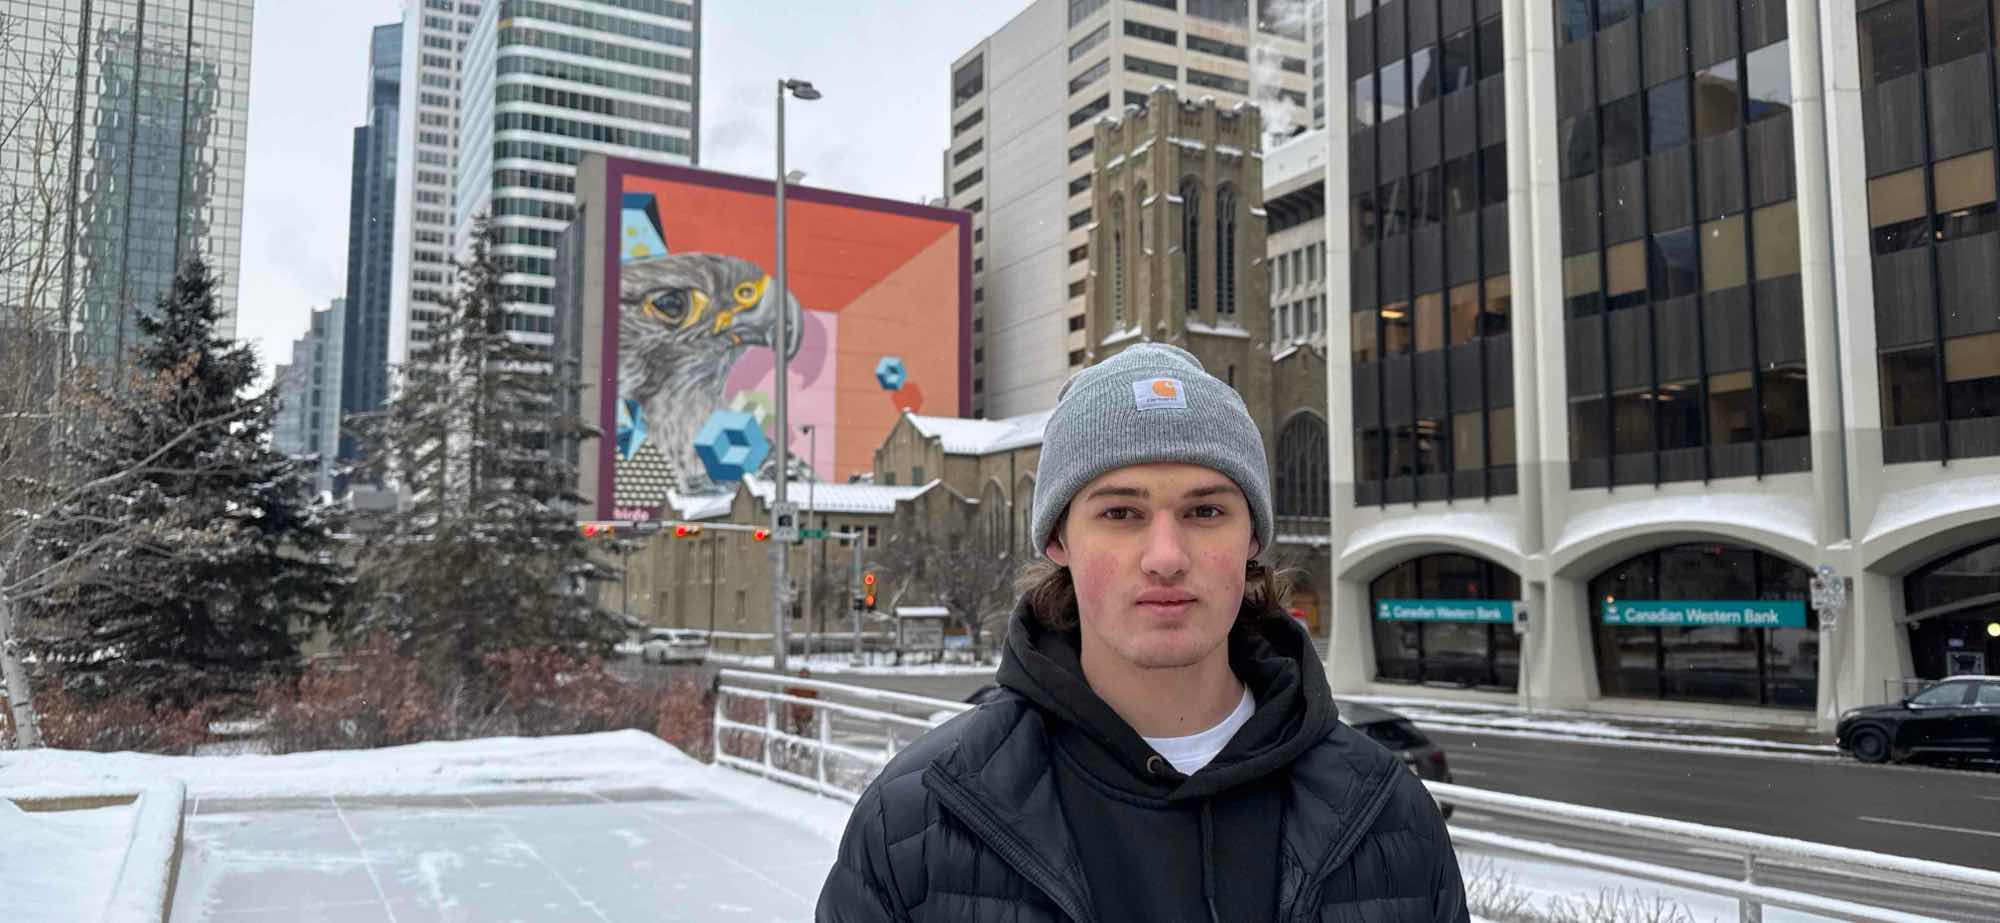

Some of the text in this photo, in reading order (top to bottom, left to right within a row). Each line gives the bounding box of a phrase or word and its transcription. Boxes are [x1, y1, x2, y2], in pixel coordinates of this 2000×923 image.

[1393, 606, 1435, 619] Canadian
[1437, 607, 1475, 619] Western
[1477, 606, 1501, 619] Bank
[1624, 607, 1779, 624] Canadian Western Bank
